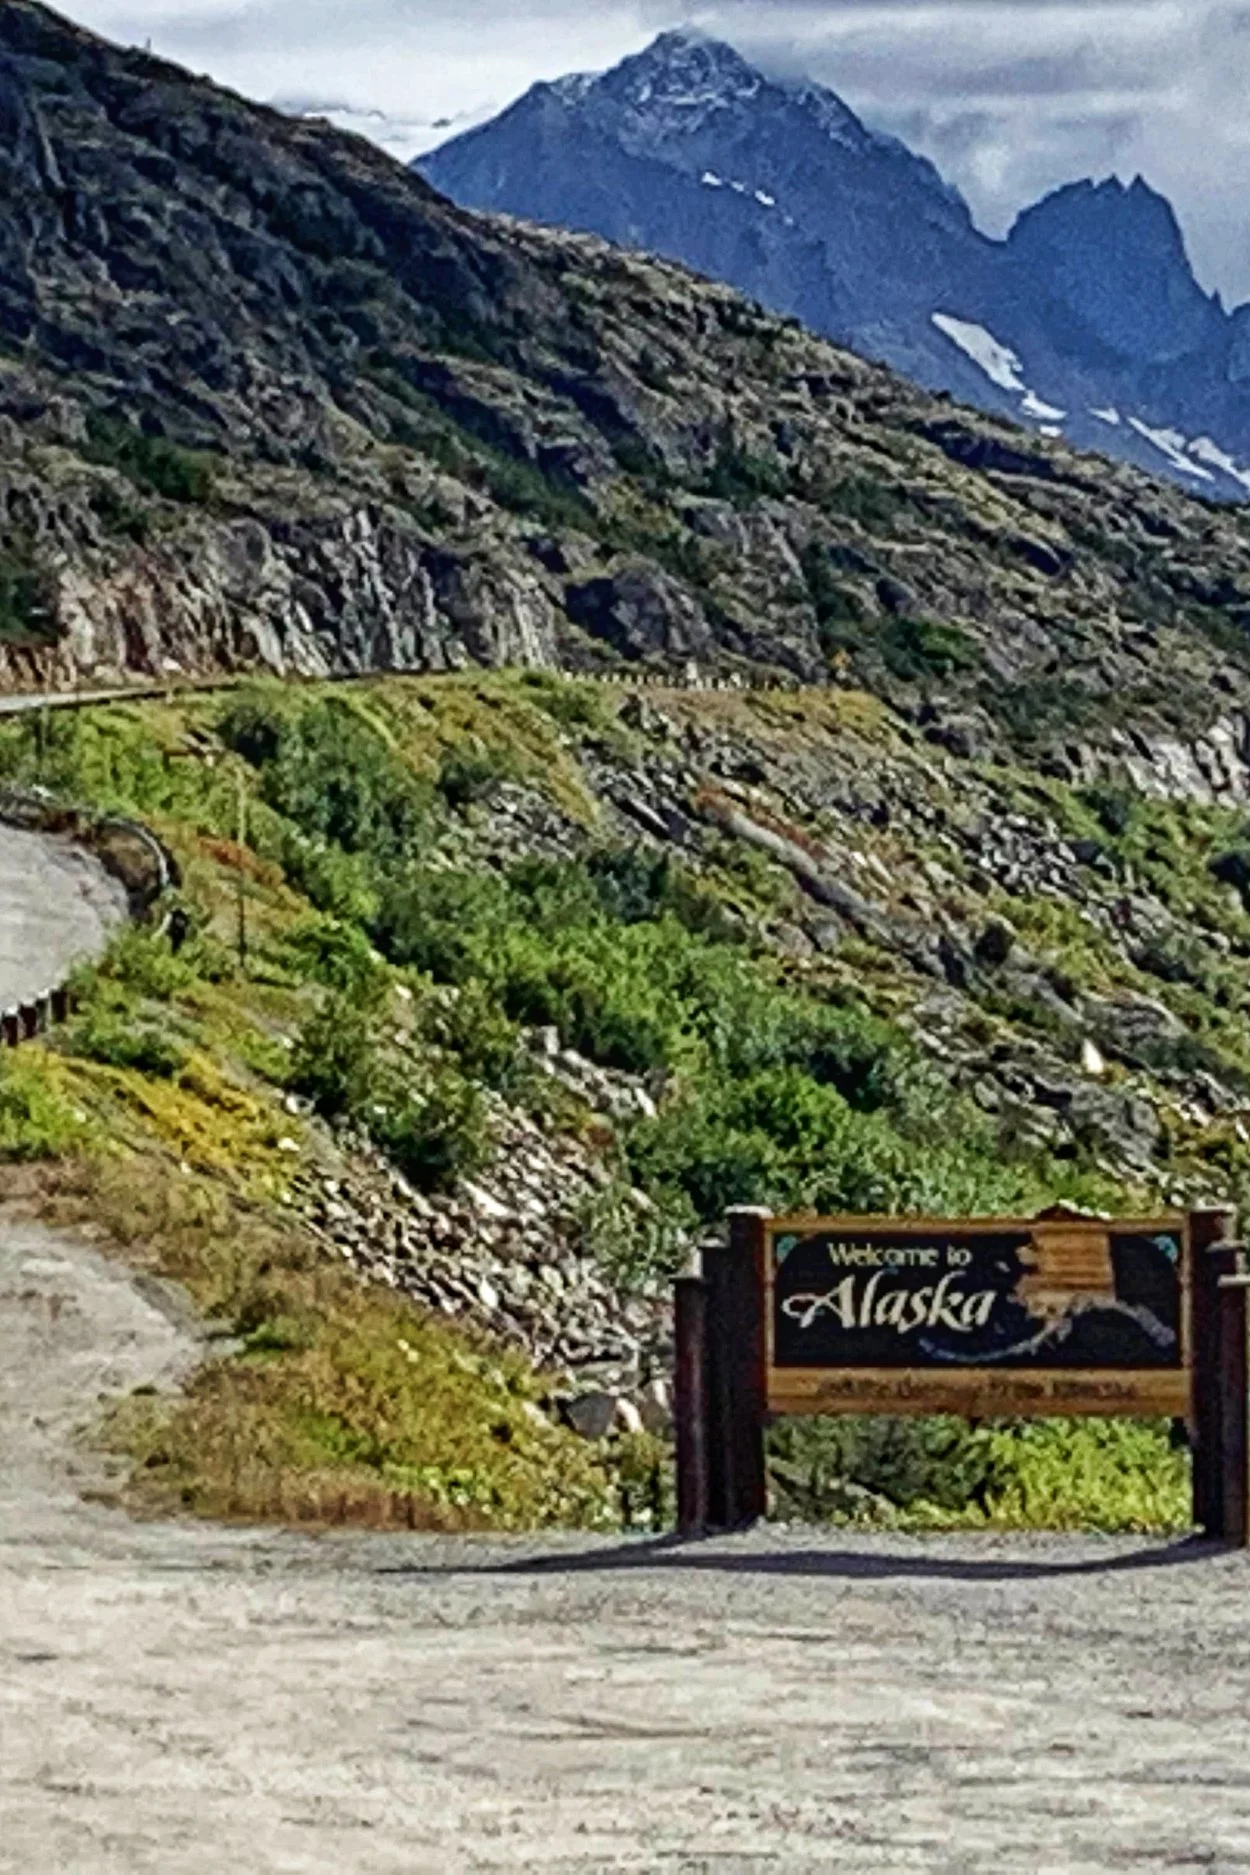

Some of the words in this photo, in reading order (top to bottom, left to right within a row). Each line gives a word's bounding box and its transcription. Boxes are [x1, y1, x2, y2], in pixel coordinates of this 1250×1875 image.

[827, 1241, 939, 1268] Welcome
[946, 1242, 973, 1267] to
[782, 1269, 997, 1334] Alaska
